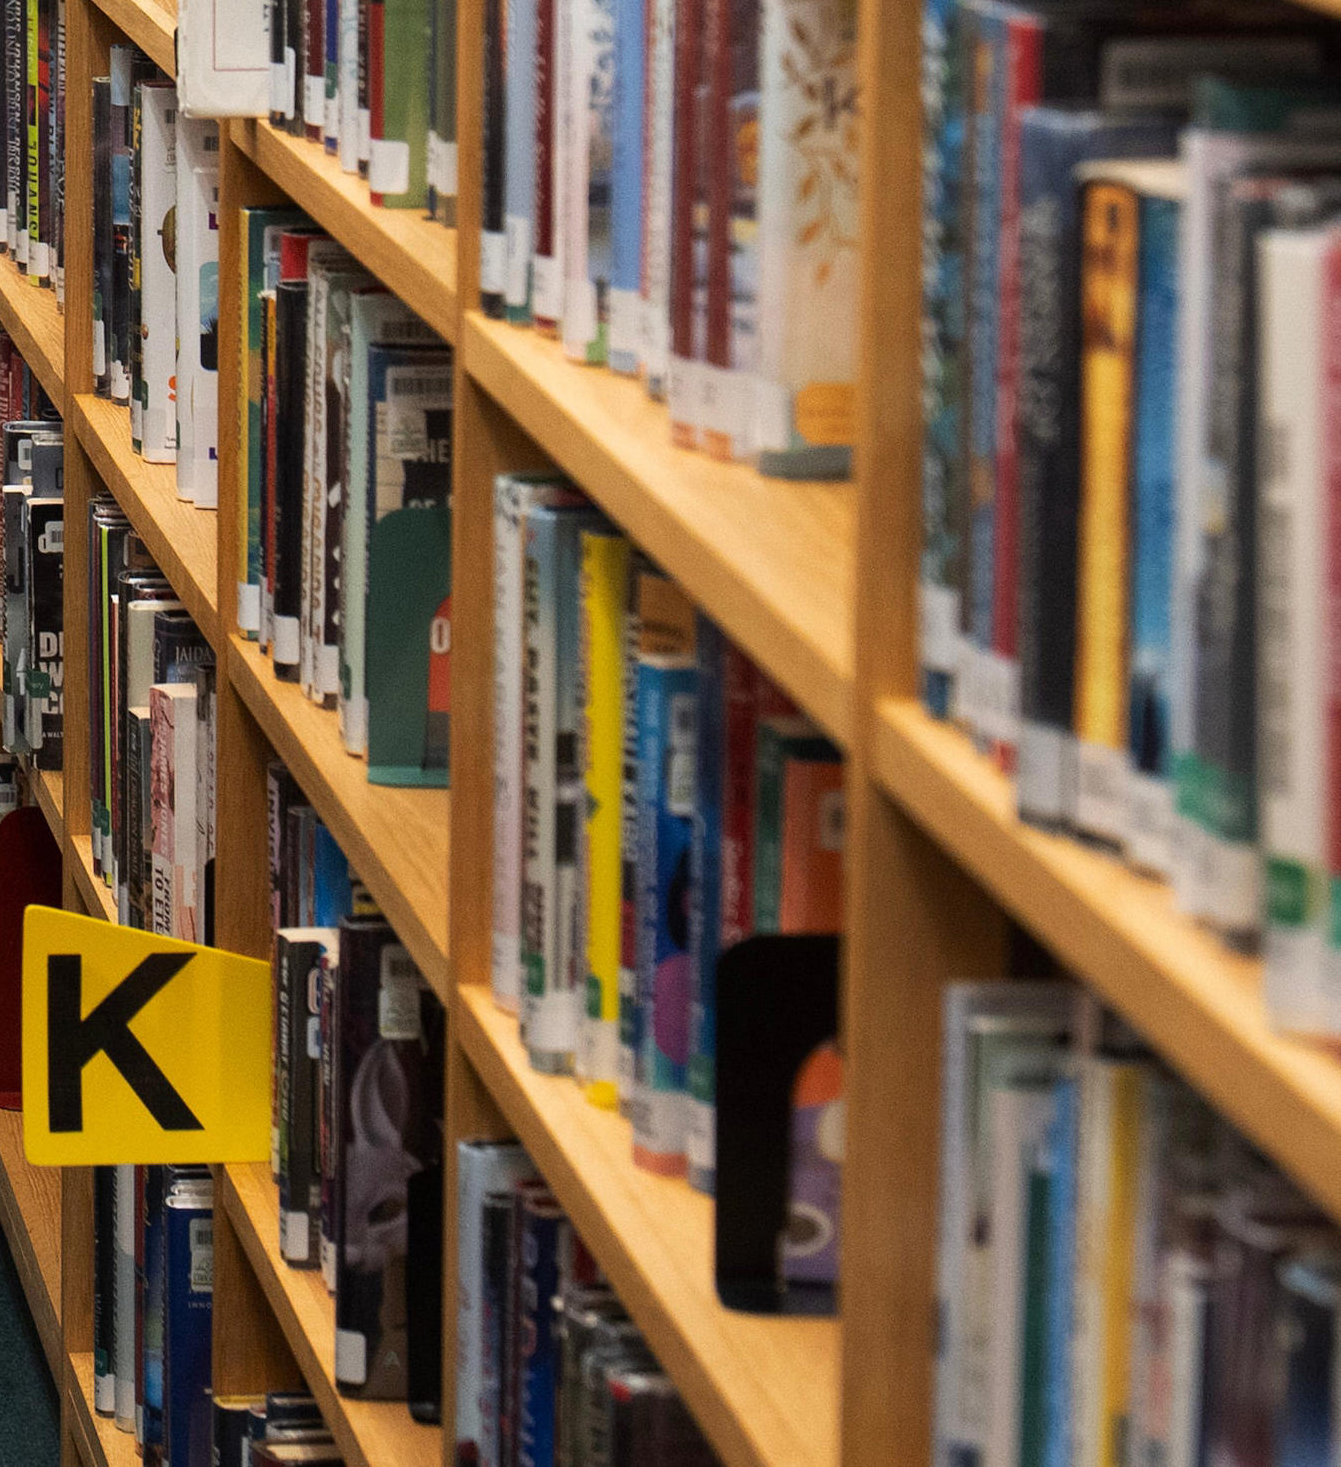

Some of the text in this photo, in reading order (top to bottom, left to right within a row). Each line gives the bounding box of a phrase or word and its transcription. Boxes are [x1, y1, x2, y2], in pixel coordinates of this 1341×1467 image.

[175, 645, 213, 663] JAIDA
[159, 737, 168, 855] JAMES JONES
[154, 901, 165, 934] ETE
[47, 952, 205, 1133] K
